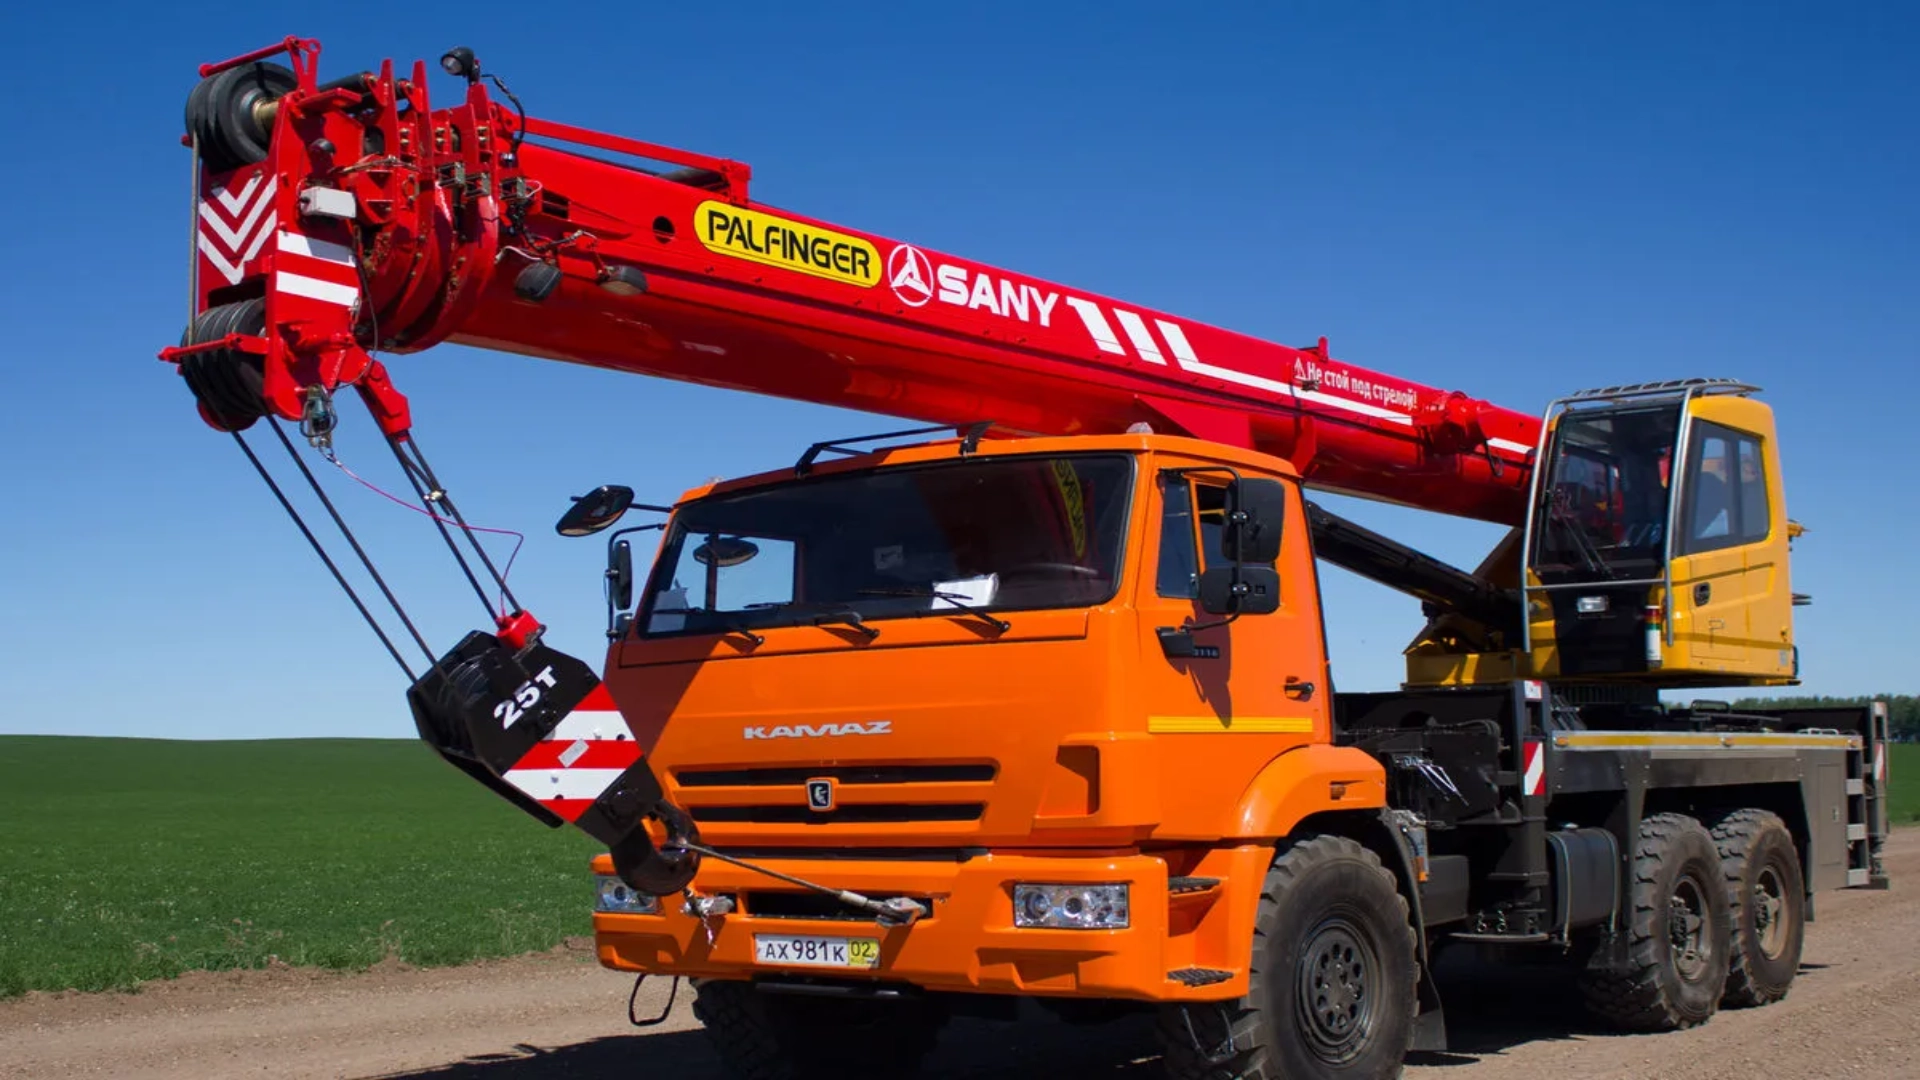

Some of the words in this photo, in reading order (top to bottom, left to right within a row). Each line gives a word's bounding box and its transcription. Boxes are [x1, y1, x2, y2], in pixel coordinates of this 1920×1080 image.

[708, 209, 870, 279] PALFINGER
[938, 264, 1059, 328] SANY
[1306, 361, 1322, 383] Не
[1324, 369, 1350, 391] стой
[1351, 377, 1372, 400] под
[1372, 384, 1417, 411] стрелой!
[743, 720, 893, 740] KAMAZ
[850, 940, 871, 958] 02
